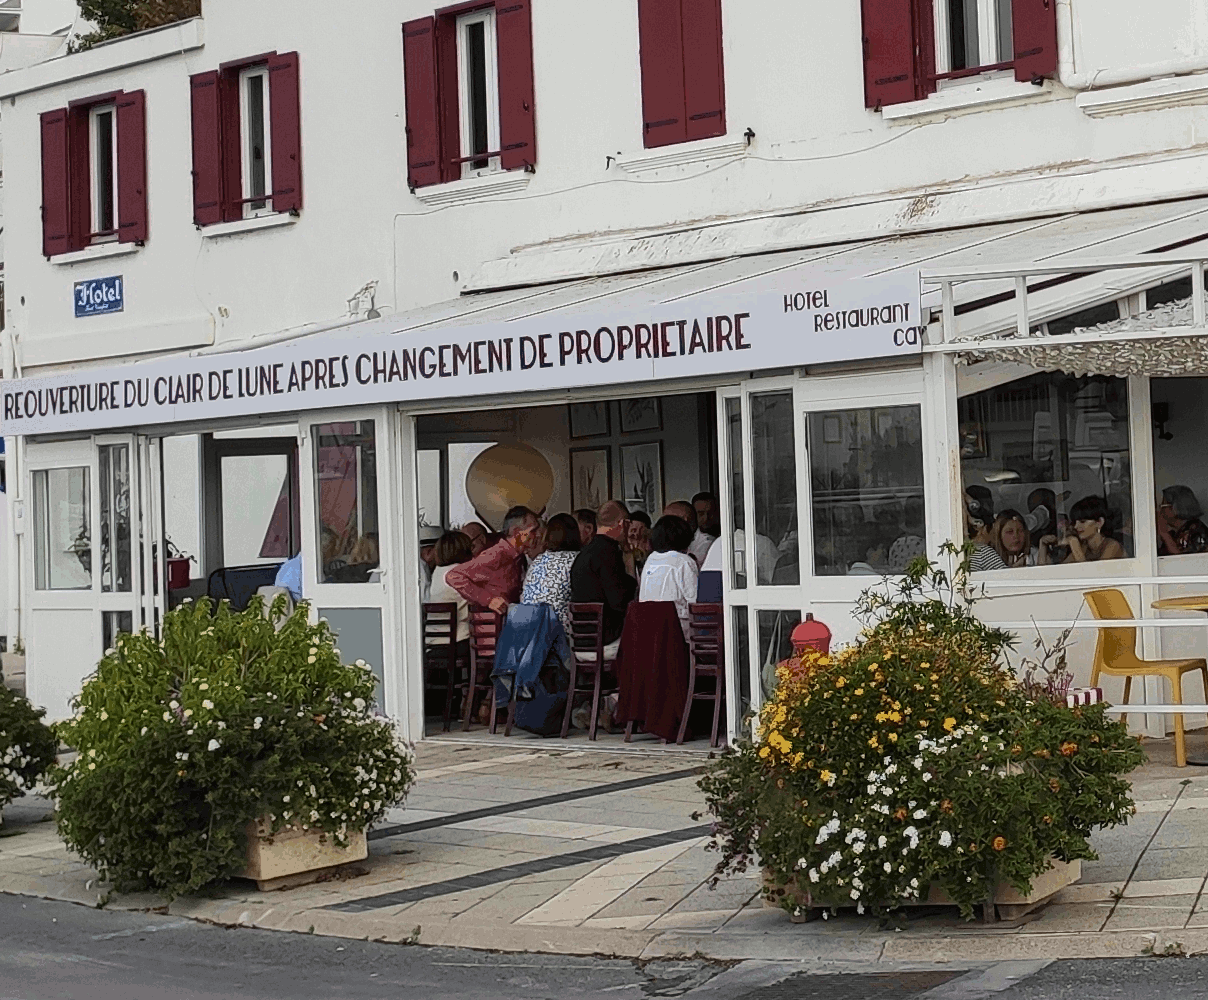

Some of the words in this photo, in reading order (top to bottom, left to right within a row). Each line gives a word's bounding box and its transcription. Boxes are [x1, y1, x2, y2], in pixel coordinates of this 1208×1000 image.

[4, 381, 120, 420] REOUVERTURE
[123, 378, 149, 408] DU
[153, 373, 204, 406] CLAIR
[208, 368, 234, 400] DE
[237, 362, 284, 398] LUNE
[287, 354, 349, 393] APRES
[355, 338, 513, 385] CHANGEMENT
[519, 332, 554, 371] DE
[558, 312, 752, 367] PROPRIETAIRE
